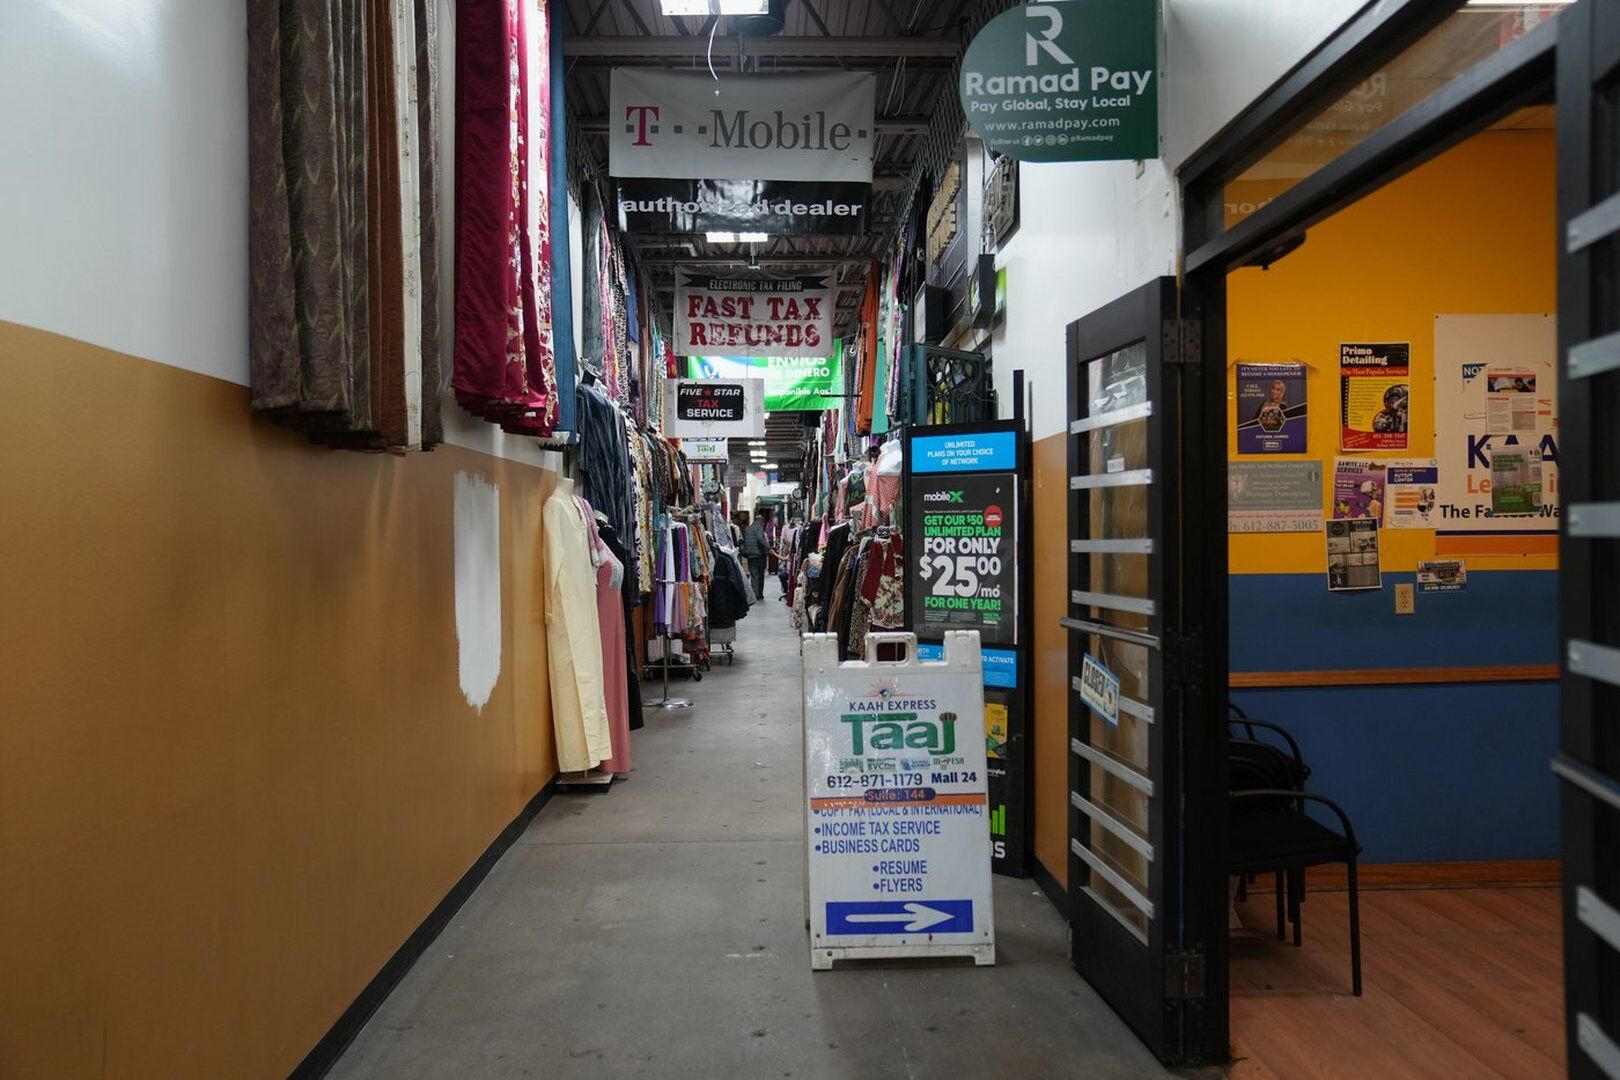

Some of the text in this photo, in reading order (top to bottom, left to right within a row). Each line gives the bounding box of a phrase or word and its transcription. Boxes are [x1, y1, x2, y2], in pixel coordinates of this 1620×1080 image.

[965, 66, 1152, 96] Ramad Pay
[971, 95, 1131, 114] Pay Global, Stay Local
[984, 117, 1120, 132] www.ramadpay.com
[622, 196, 862, 216] authorized dealer
[709, 279, 802, 291] ELECTRONIC TAX FILING
[688, 295, 822, 321] FAST TAX
[689, 322, 822, 347] REFUNDS
[1342, 346, 1373, 355] Primo
[1342, 355, 1388, 366] Detailing
[679, 388, 741, 396] FIVE STAR
[697, 399, 719, 408] TAX
[686, 408, 734, 418] SERVICE
[944, 441, 976, 449] UNLIMITED
[972, 448, 993, 456] CHOICE
[950, 457, 978, 465] NETWORK
[923, 491, 964, 503] mobileX
[1440, 505, 1469, 518] The
[1539, 504, 1560, 518] Wa
[924, 515, 943, 526] GET
[944, 515, 966, 525] OUR
[966, 514, 983, 526] $50
[924, 526, 1001, 537] UNLIMITED PLAN
[924, 537, 1001, 554] FOR ONLY
[924, 597, 1001, 611] FOR ONE YEAR!
[988, 656, 1014, 664] ACTIVATE
[849, 700, 936, 712] KAAH EXPRESS
[840, 711, 957, 756] Taaj
[827, 772, 923, 788] 612-871-1179
[931, 772, 958, 784] Mall
[962, 771, 977, 783] 24
[866, 789, 925, 801] Suite: 144
[902, 804, 909, 816] &
[910, 803, 982, 817] INTERNATIONAL)
[822, 820, 941, 836] INCOME TAX SERVICE
[822, 838, 920, 854] BUSINESS CARDS
[880, 860, 928, 875] RESUME
[880, 878, 923, 892] FLYERS
